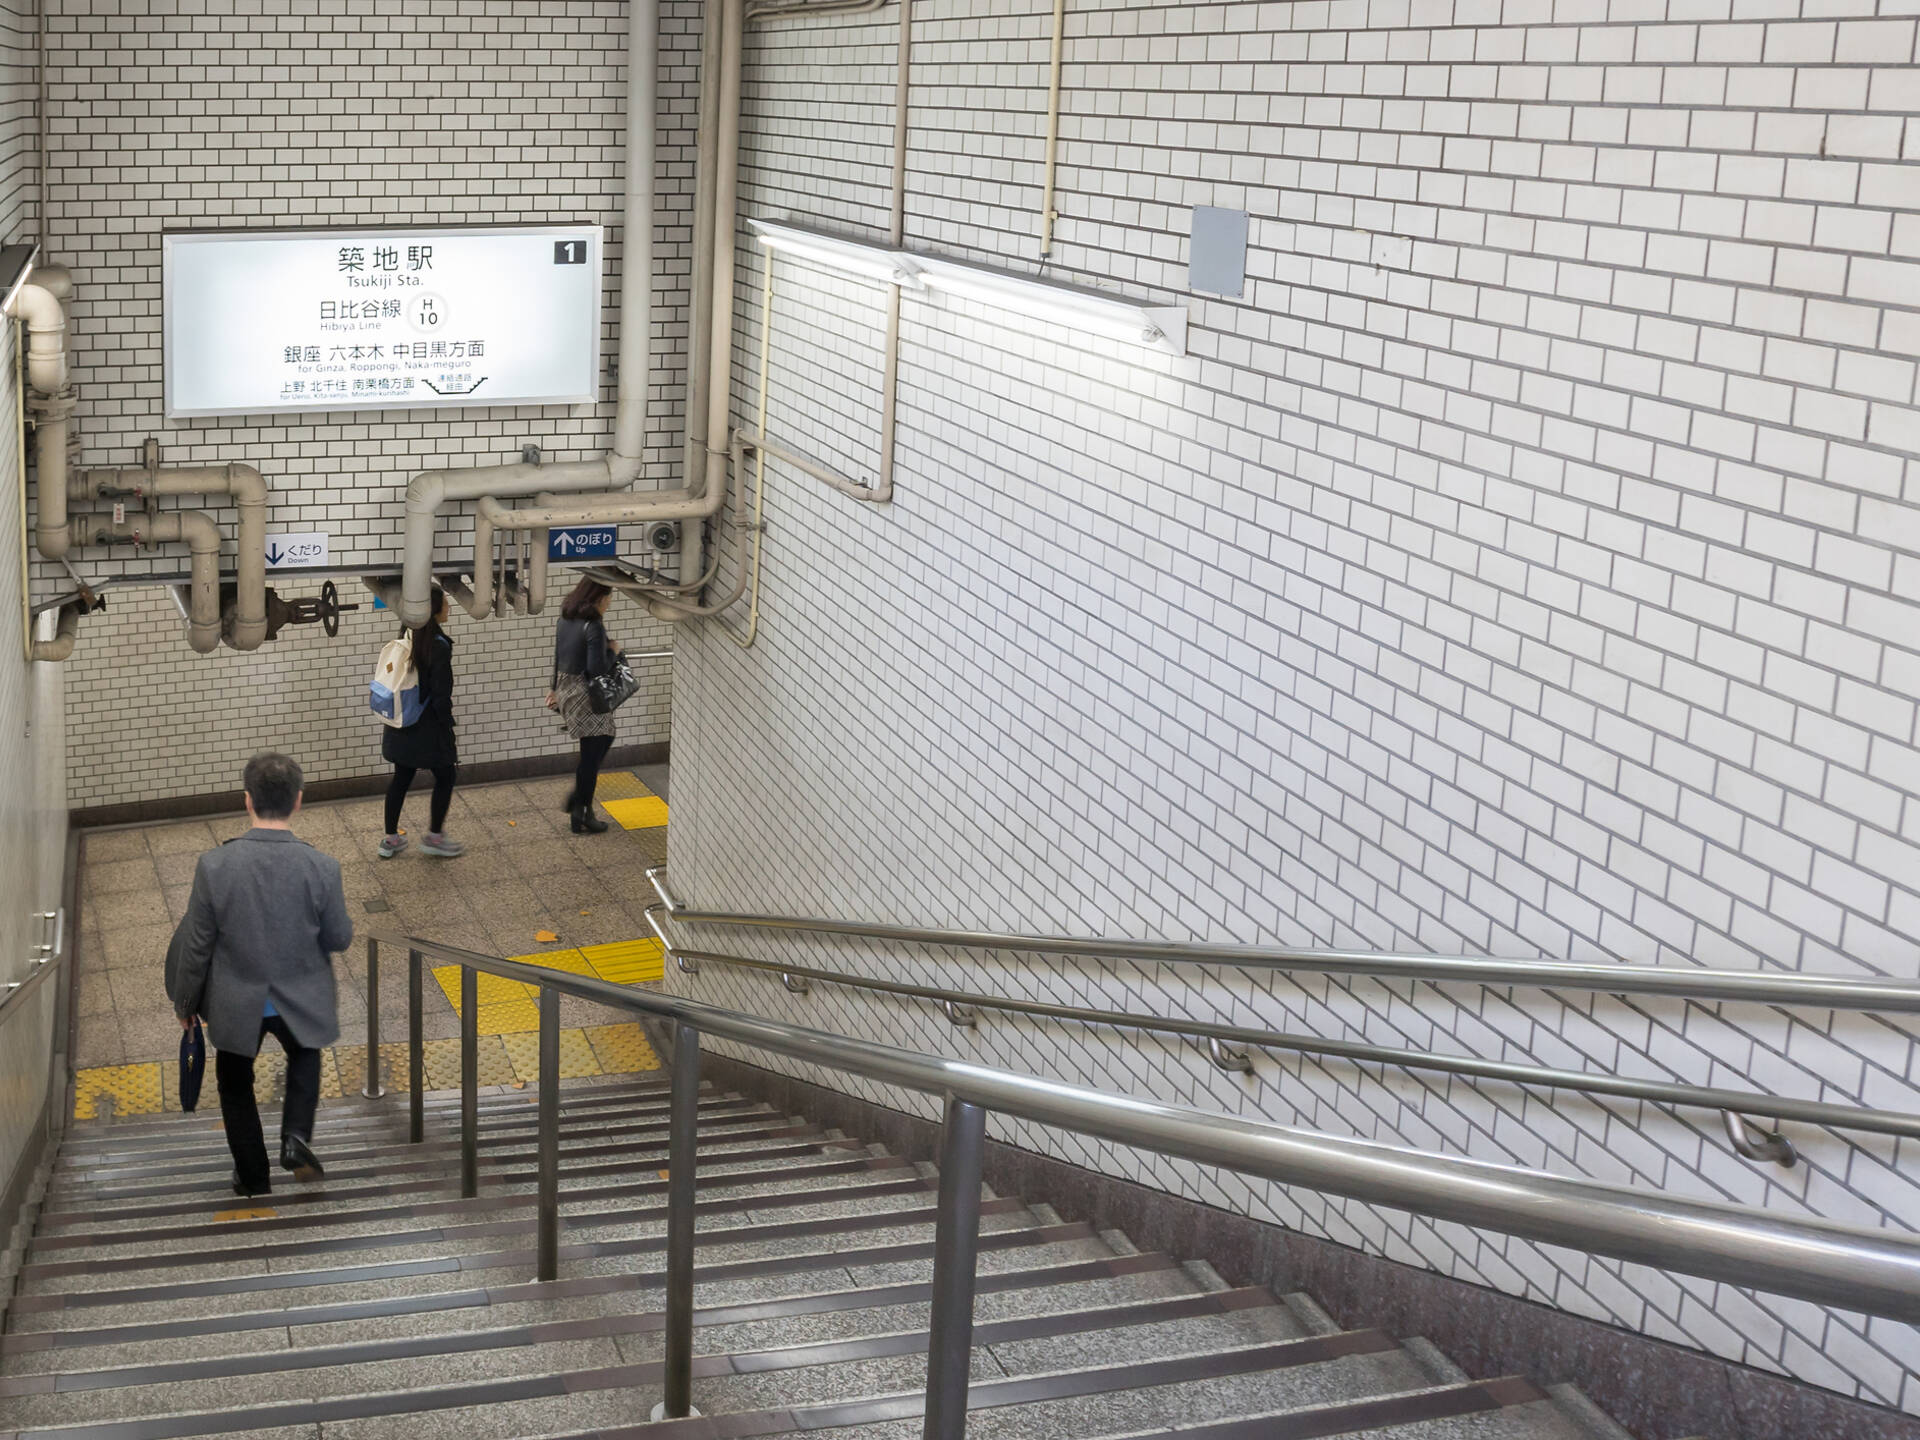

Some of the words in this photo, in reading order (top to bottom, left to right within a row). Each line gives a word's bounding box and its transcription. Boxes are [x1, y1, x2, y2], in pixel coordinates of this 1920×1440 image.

[338, 245, 433, 272] 築地駅
[564, 242, 575, 262] 1
[347, 274, 392, 290] Tsukiji
[397, 274, 424, 286] Sta.
[320, 299, 401, 319] 日比谷線
[423, 299, 433, 310] H
[420, 312, 438, 325] 10
[320, 322, 355, 332] Hibiya
[359, 321, 382, 330] Line
[284, 345, 321, 363] 銀座
[329, 343, 385, 361] 六本木
[393, 340, 485, 359] 中目黒方面
[298, 365, 312, 374] for
[404, 359, 472, 370] Naka-meguro
[280, 380, 306, 393] 上野
[310, 379, 348, 392] 北千住
[575, 532, 612, 546] のぼり
[288, 544, 322, 556] くだり
[575, 546, 586, 554] Up
